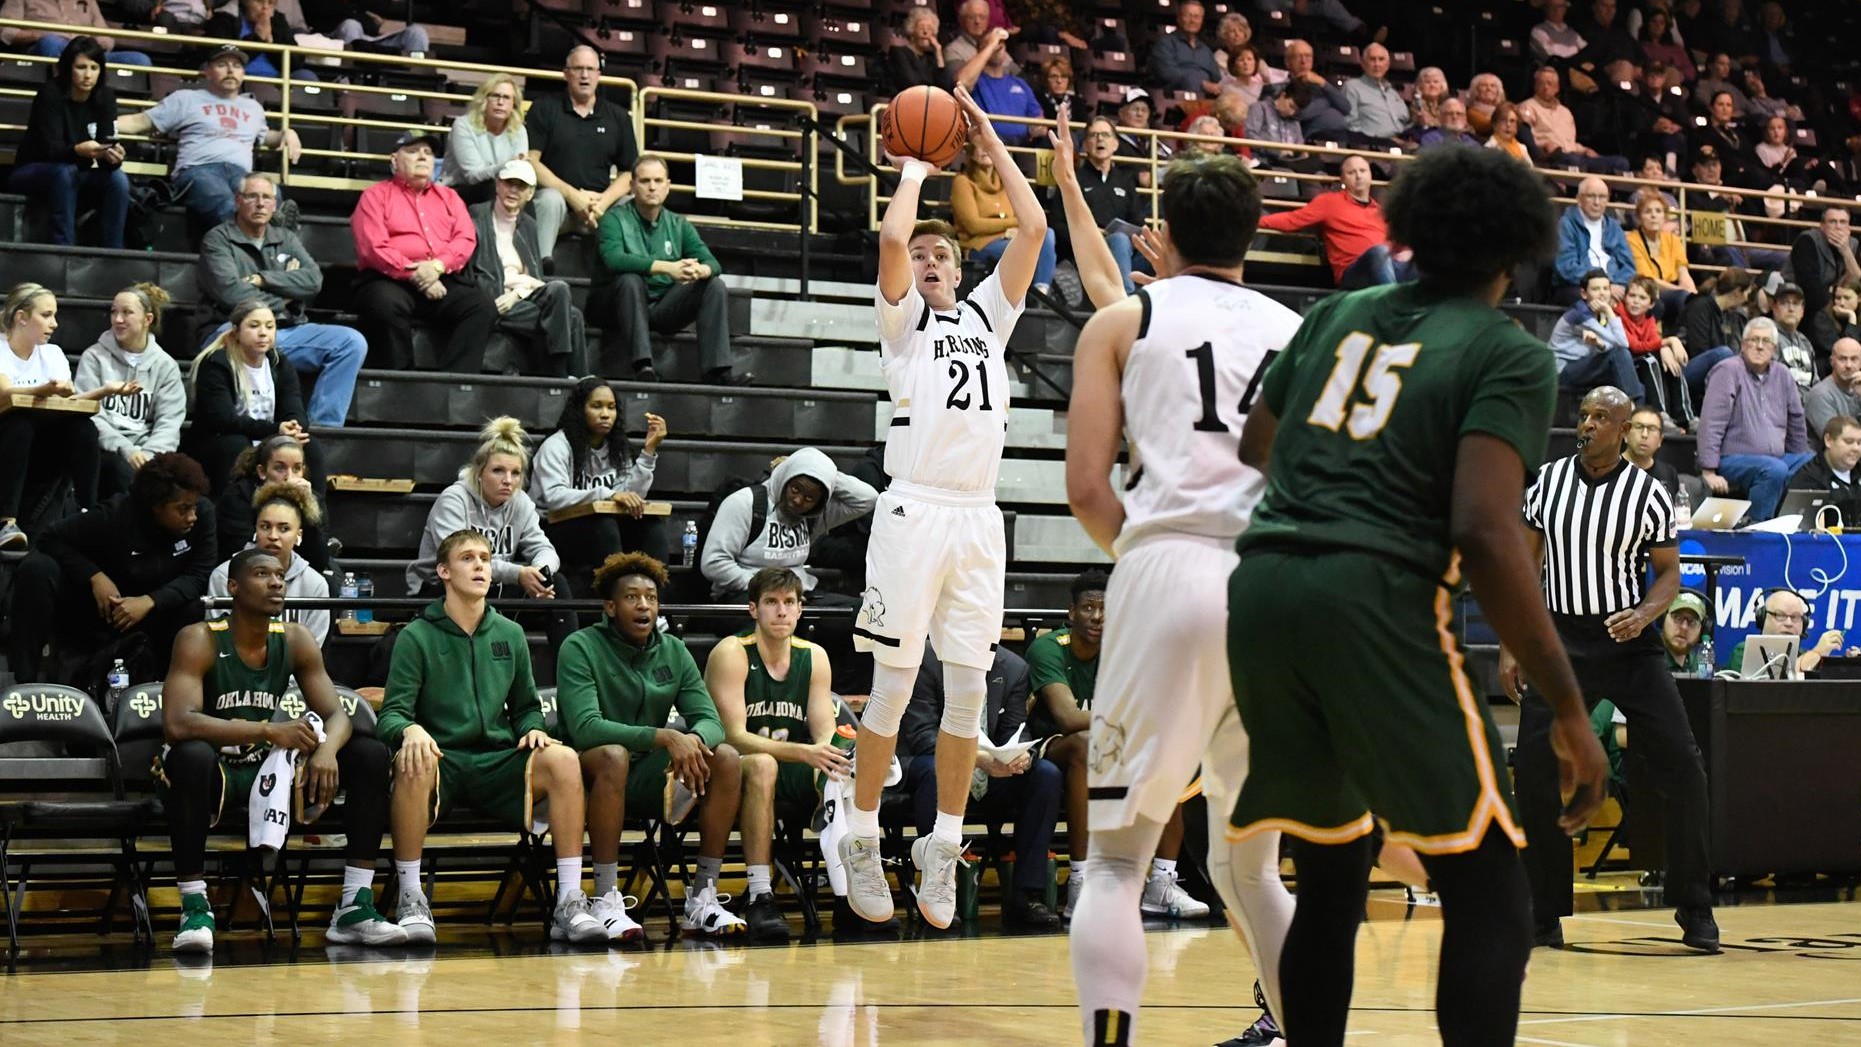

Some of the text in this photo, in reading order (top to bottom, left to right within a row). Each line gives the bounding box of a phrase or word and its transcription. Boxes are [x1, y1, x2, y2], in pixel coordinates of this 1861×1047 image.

[202, 103, 250, 122] FDNY
[1694, 217, 1725, 238] HOME
[946, 360, 992, 411] 21
[1307, 330, 1423, 440] 15
[1680, 563, 1706, 575] NCAA
[1825, 589, 1861, 630] IT
[31, 693, 85, 717] Unity
[216, 690, 279, 710] OKLAHOM
[36, 712, 72, 721] HEALTH
